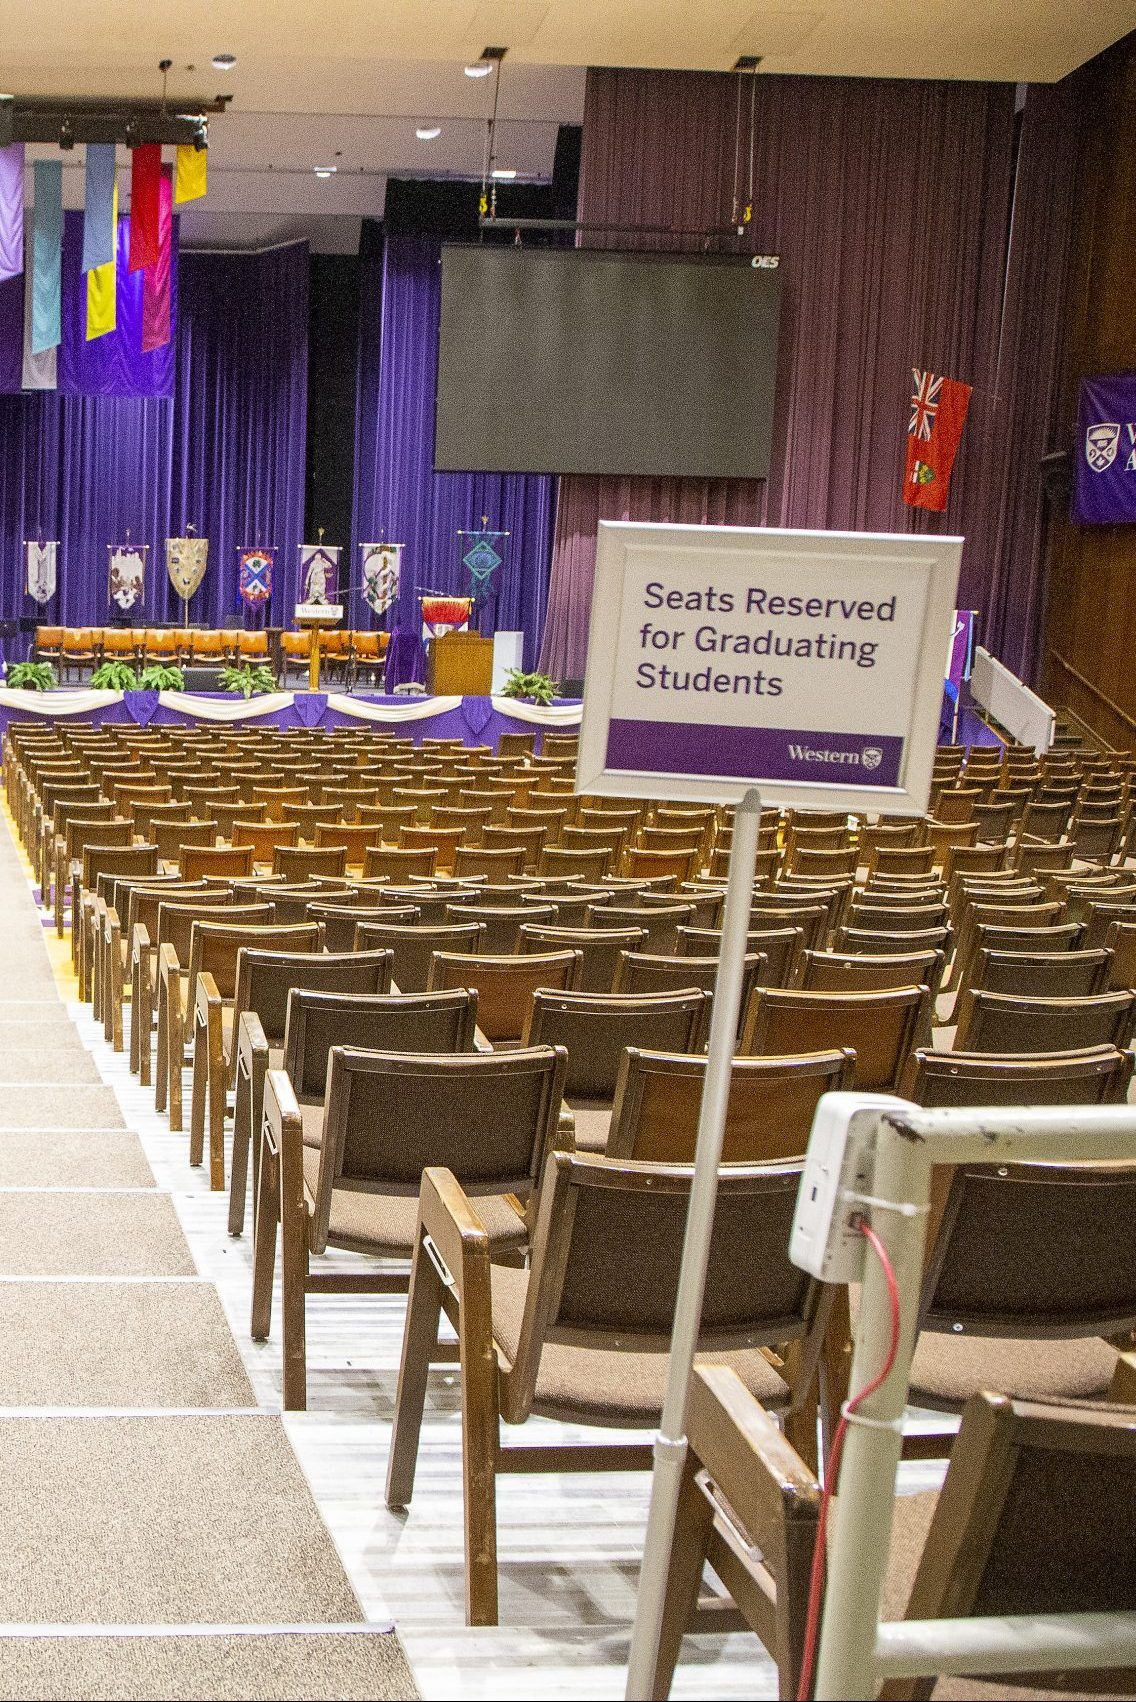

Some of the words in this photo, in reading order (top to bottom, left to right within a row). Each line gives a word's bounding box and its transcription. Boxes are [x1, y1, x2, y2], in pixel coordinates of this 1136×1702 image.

[751, 255, 780, 269] OES
[643, 582, 735, 613] Seats
[746, 587, 897, 622] Reserved
[639, 623, 685, 650] for
[695, 625, 879, 668] Graduating
[636, 662, 783, 697] Students
[787, 744, 860, 765] Western
